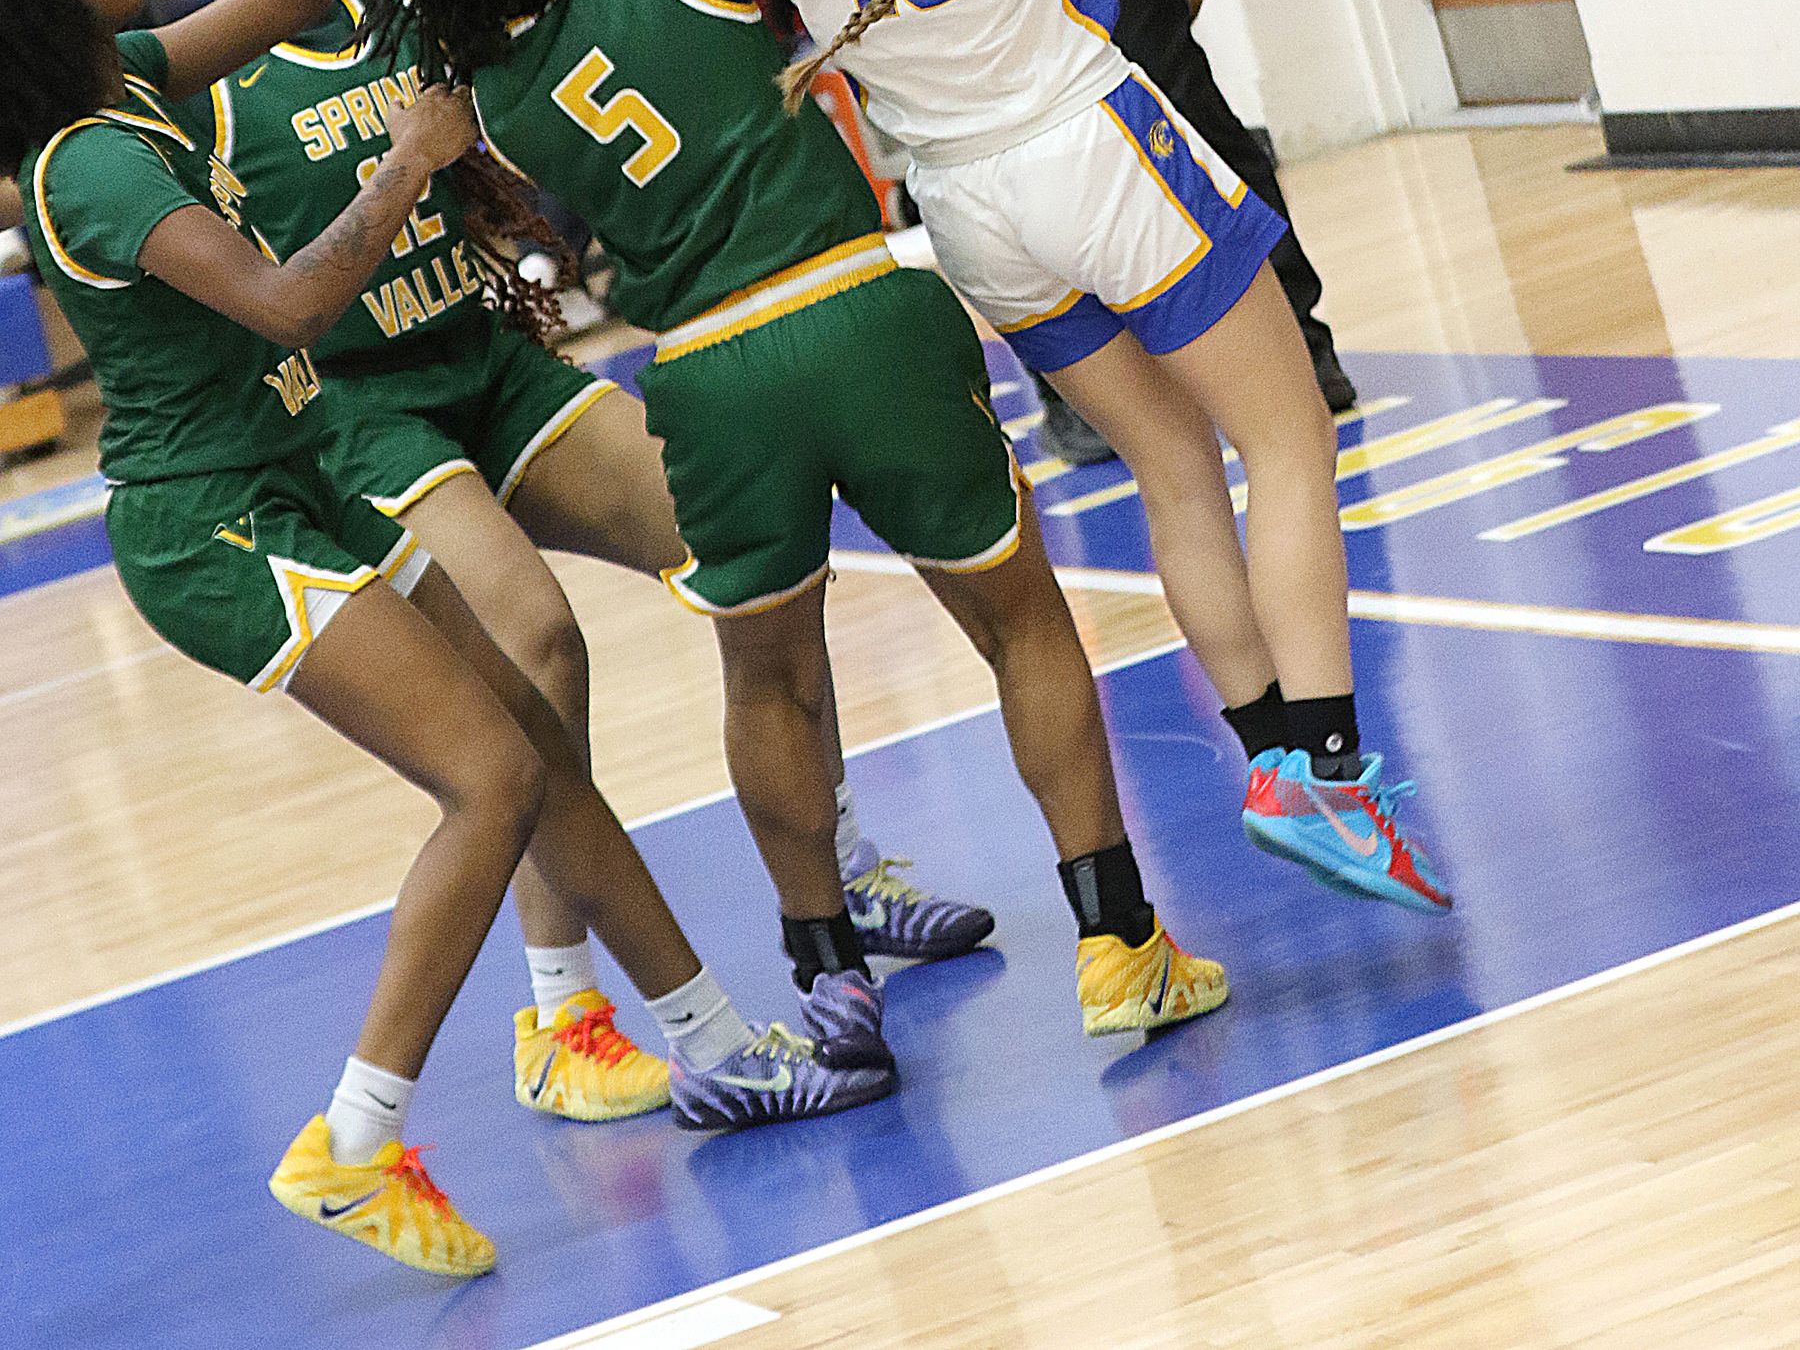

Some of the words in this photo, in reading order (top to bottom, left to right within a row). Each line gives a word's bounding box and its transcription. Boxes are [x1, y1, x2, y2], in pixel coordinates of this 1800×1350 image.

[291, 64, 424, 162] SPRIN
[551, 46, 681, 189] 5
[361, 240, 484, 338] VALLE
